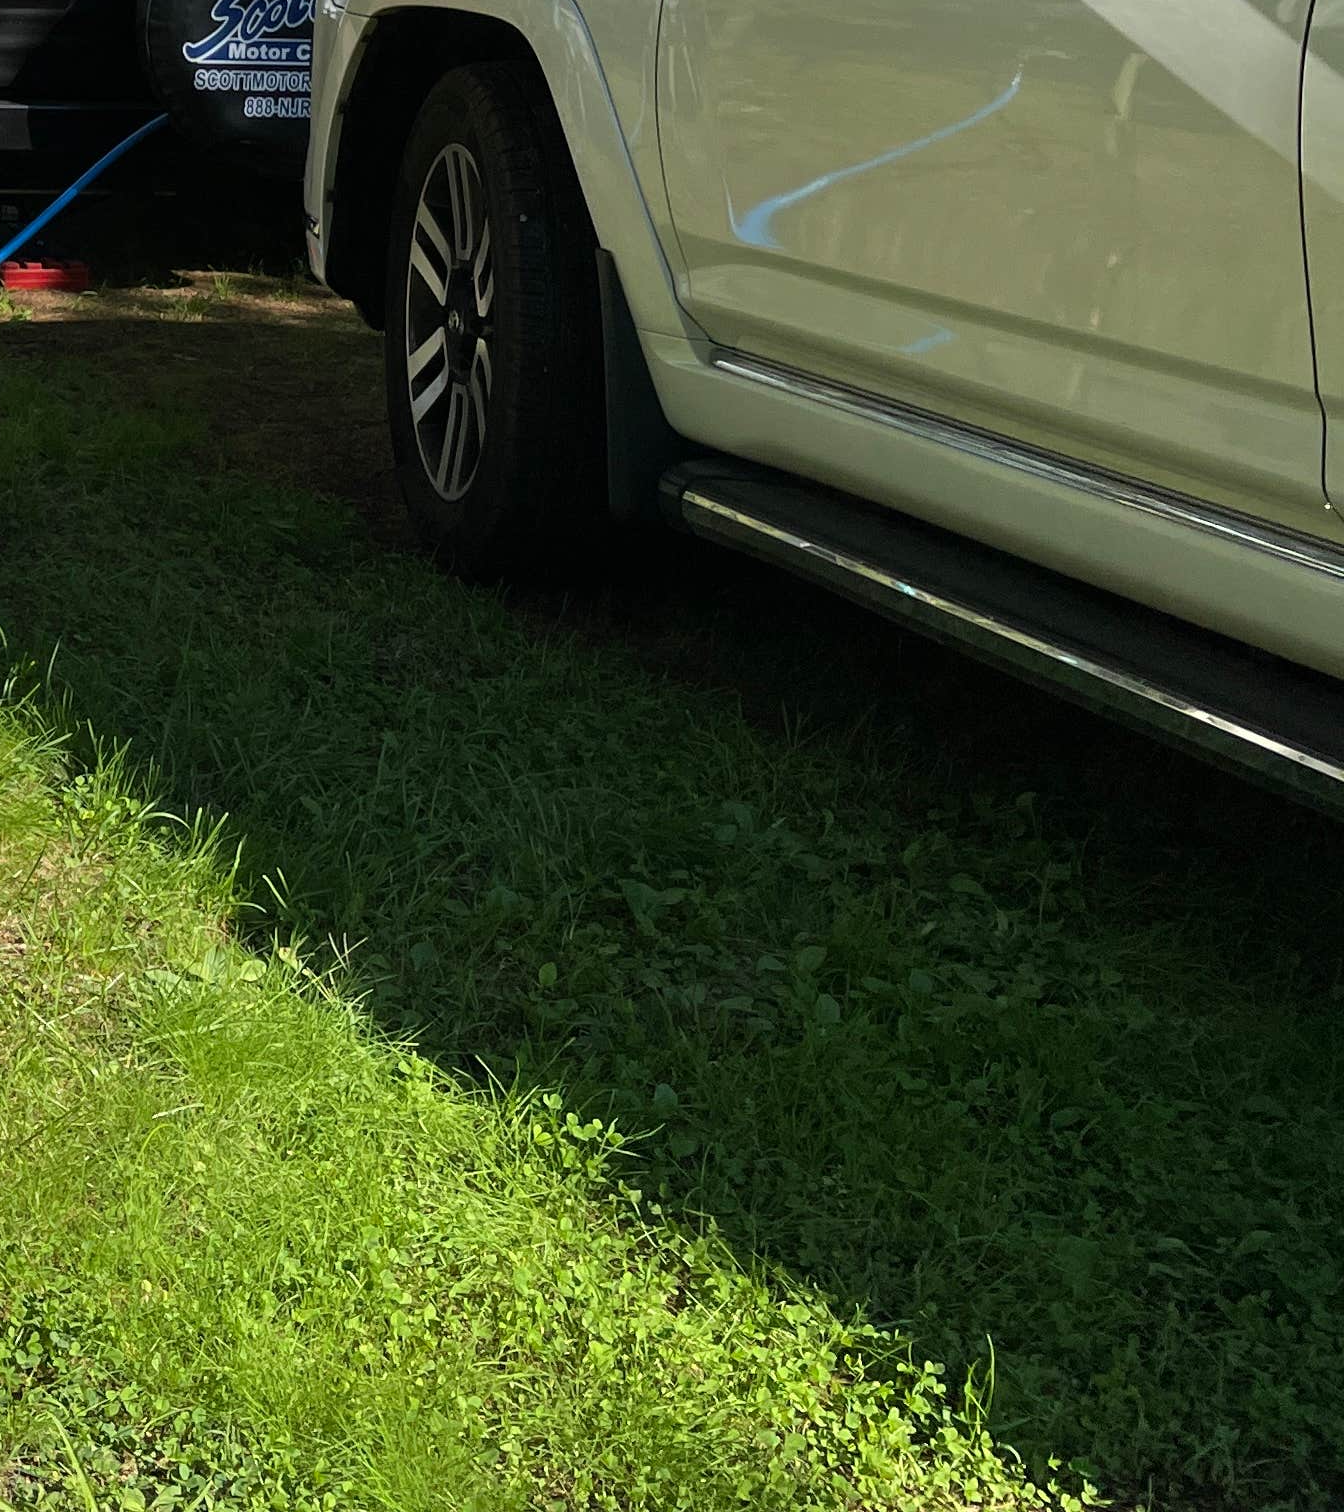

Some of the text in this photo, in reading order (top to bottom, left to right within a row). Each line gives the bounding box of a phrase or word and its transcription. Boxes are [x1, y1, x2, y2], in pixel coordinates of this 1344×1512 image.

[228, 42, 291, 60] Motor
[194, 69, 312, 91] SCOTTMOTOR
[244, 97, 312, 118] 888-NJR
